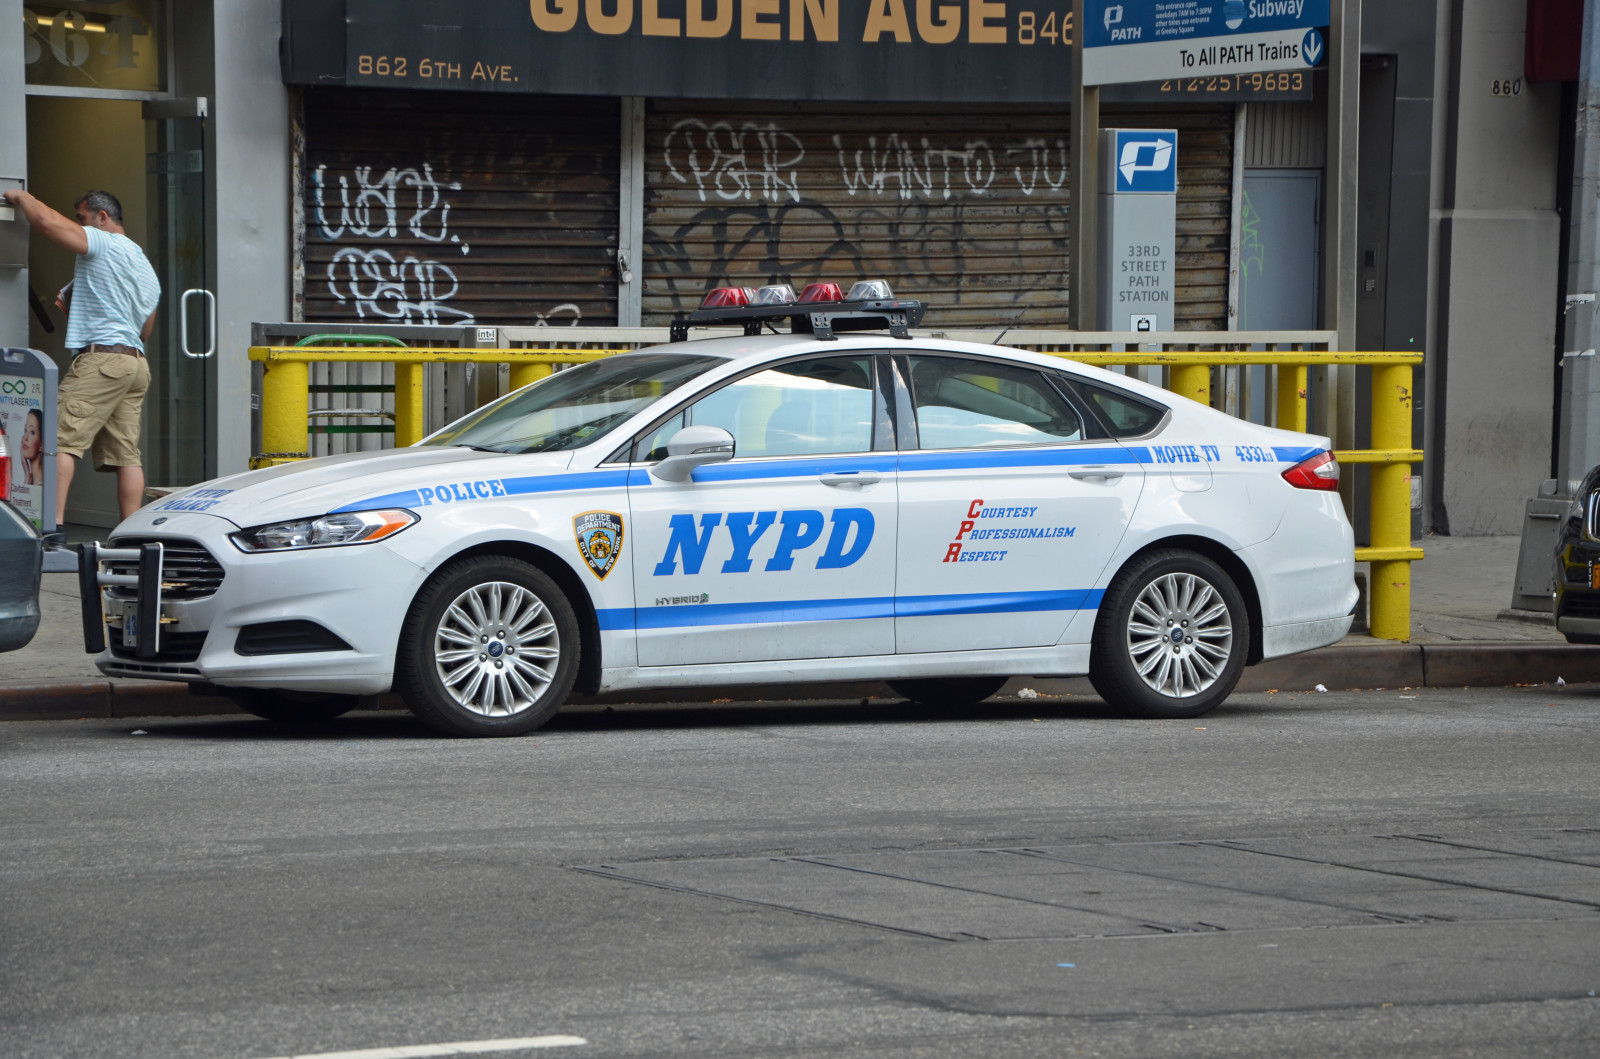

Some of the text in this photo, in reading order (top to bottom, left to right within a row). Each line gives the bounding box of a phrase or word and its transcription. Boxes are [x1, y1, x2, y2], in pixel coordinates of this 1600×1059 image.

[1155, 1, 1198, 11] This entrance open
[1249, 0, 1305, 19] Subway
[1155, 10, 1178, 19] weekdays
[1155, 19, 1168, 27] other
[1168, 18, 1180, 26] times
[1190, 16, 1210, 24] entrance
[530, 0, 1007, 44] GOLDEN AGE
[1111, 27, 1142, 41] PATH
[1178, 26, 1195, 35] Square
[1180, 41, 1299, 67] To All PATH Trains
[358, 55, 408, 77] 862
[419, 59, 461, 80] 6TH
[1493, 80, 1521, 95] 860
[1128, 246, 1160, 257] 33RD
[1121, 261, 1167, 272] STREET
[1129, 275, 1160, 287] PATH
[1119, 290, 1169, 302] STATION
[1152, 445, 1200, 463] MOVIE
[1201, 445, 1221, 462] TV
[418, 479, 505, 507] POLICE
[152, 499, 222, 511] POLICE
[967, 499, 1038, 518] COURTESY
[584, 513, 611, 522] POLICE
[577, 520, 621, 534] DEPARTMENT
[955, 520, 1076, 540] PROFESSIONALISM
[653, 507, 876, 577] NYPD
[579, 536, 622, 571] CITY OF NEW YORK
[943, 543, 1008, 562] RESPECT
[655, 595, 699, 606] HYBRID
